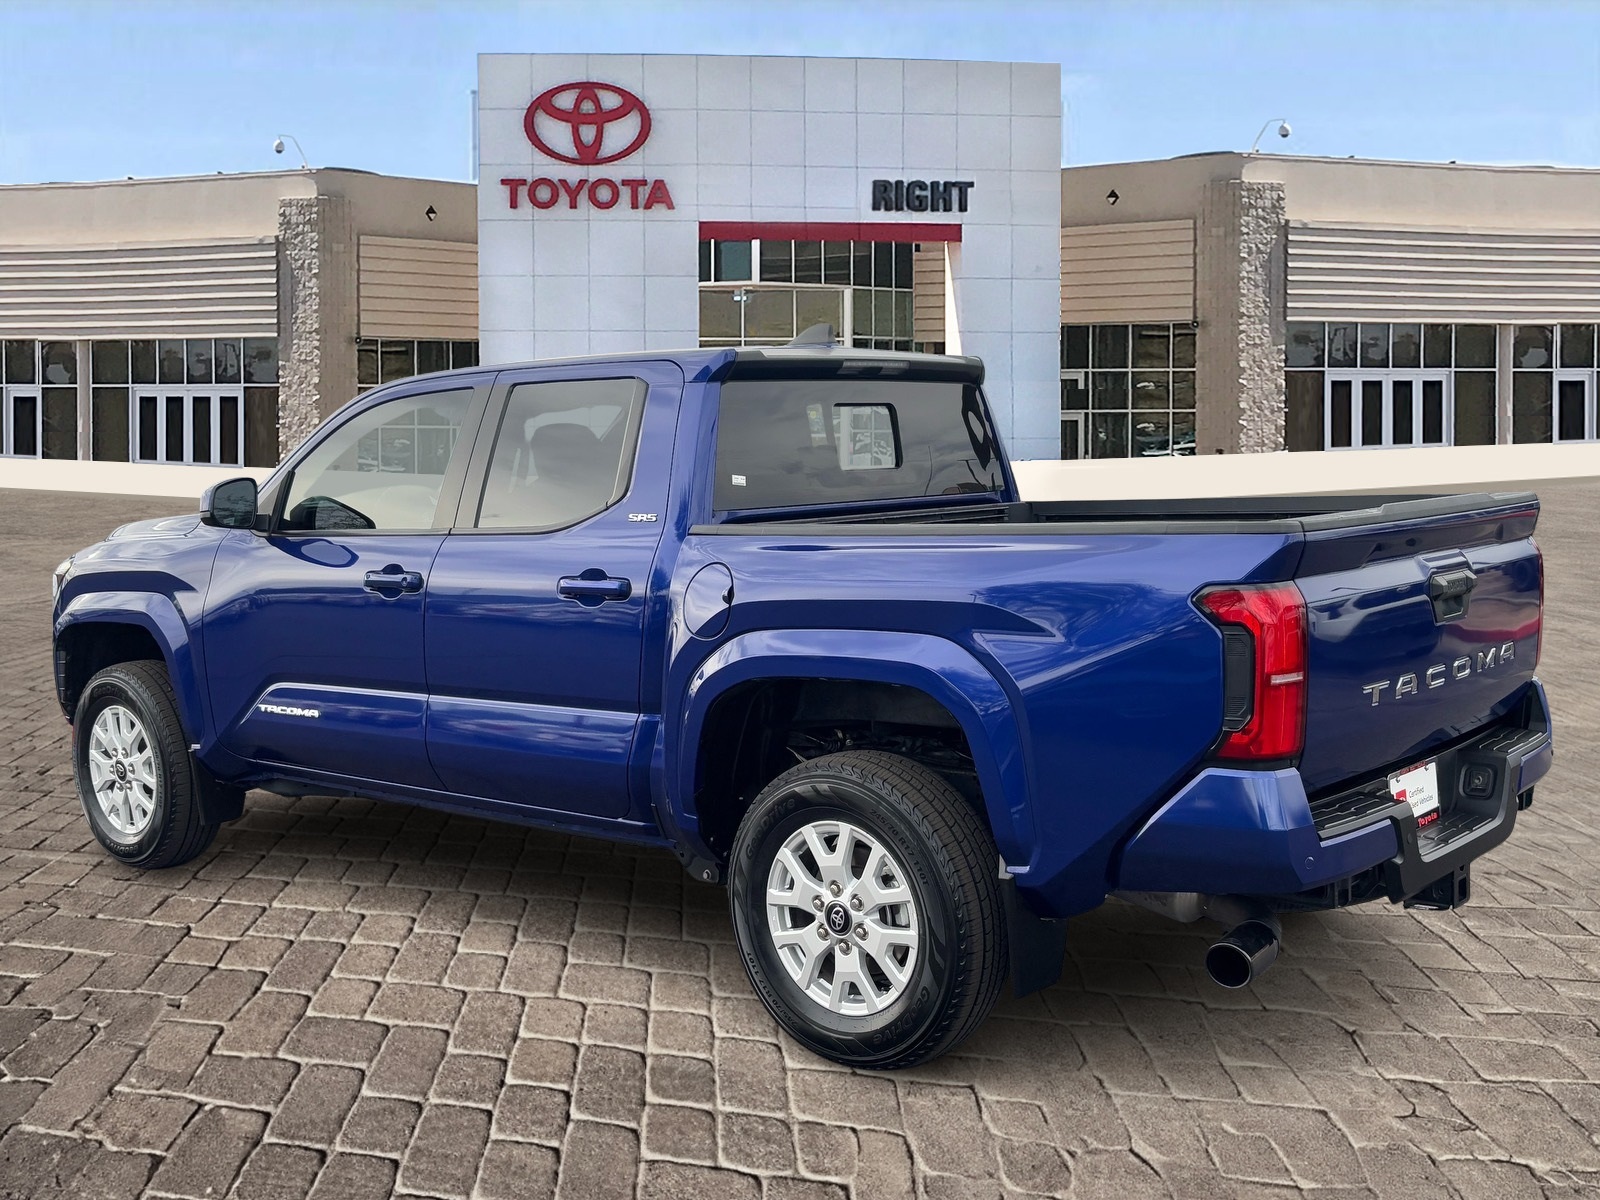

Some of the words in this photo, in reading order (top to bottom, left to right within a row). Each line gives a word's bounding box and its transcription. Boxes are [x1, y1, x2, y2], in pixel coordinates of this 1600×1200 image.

[500, 178, 675, 210] TOYOTA
[872, 180, 974, 213] RIGHT
[628, 513, 657, 522] SR5
[1362, 641, 1515, 707] TACOMA
[258, 704, 319, 718] TACOMA
[1409, 786, 1424, 798] Certified
[1419, 794, 1434, 805] Vehicles
[1418, 812, 1438, 828] Toyota
[869, 809, 899, 836] 245/70
[898, 837, 915, 857] R17
[913, 861, 930, 886] 110T
